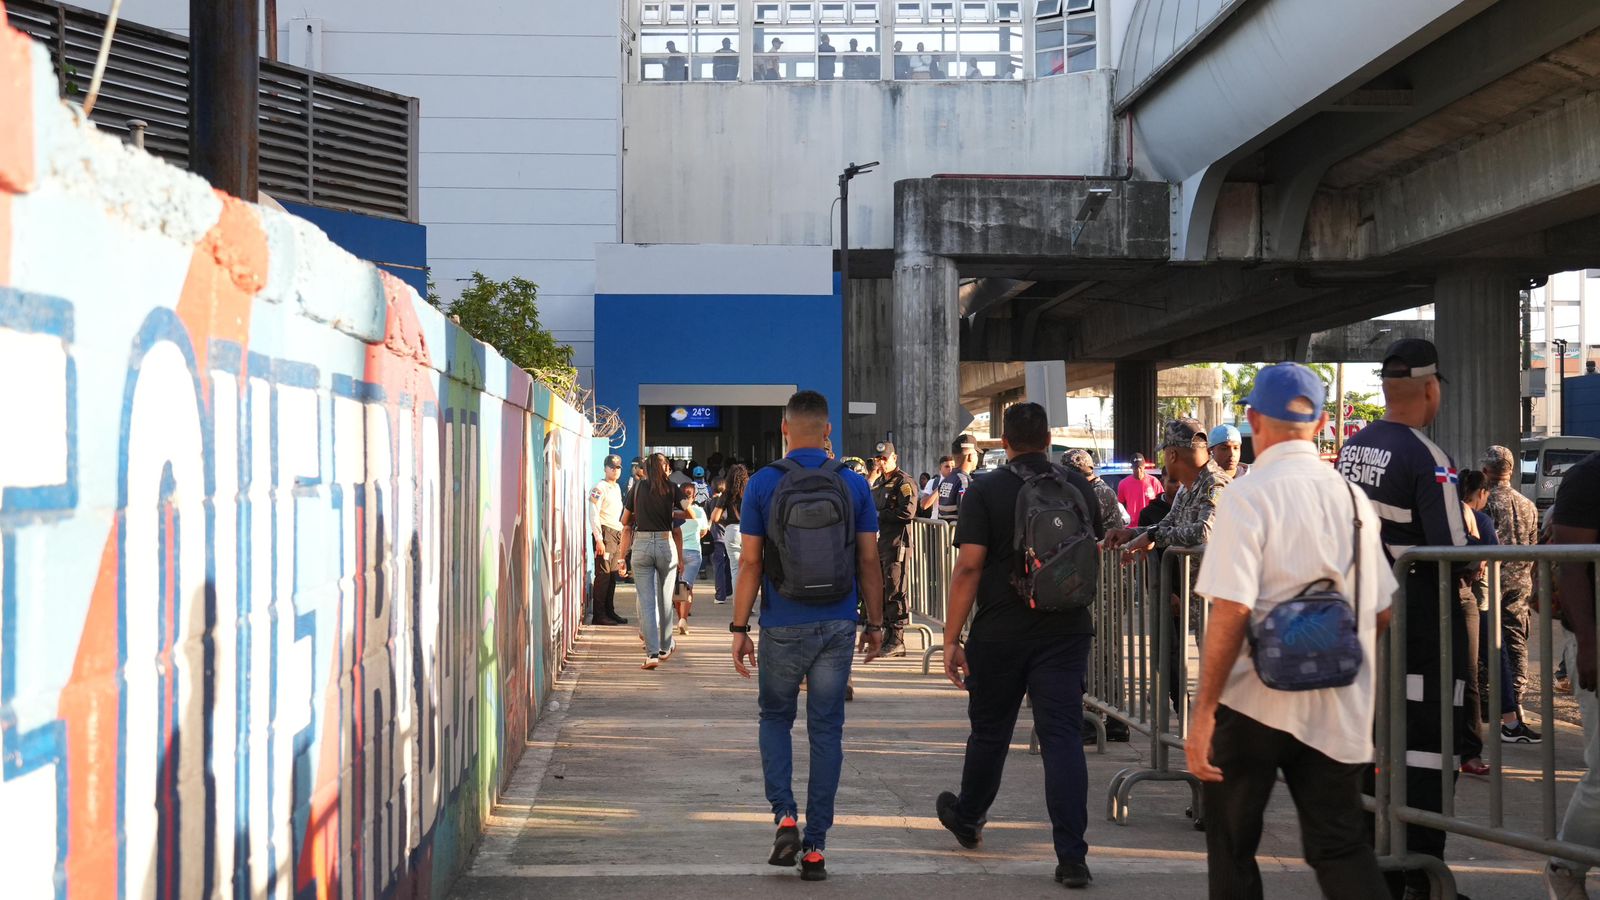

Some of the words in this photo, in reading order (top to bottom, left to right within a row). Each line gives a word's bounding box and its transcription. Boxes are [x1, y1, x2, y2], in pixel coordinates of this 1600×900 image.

[692, 408, 711, 416] 24°C
[1340, 445, 1392, 468] SEGURIDAD
[330, 372, 481, 900] TRABAJA
